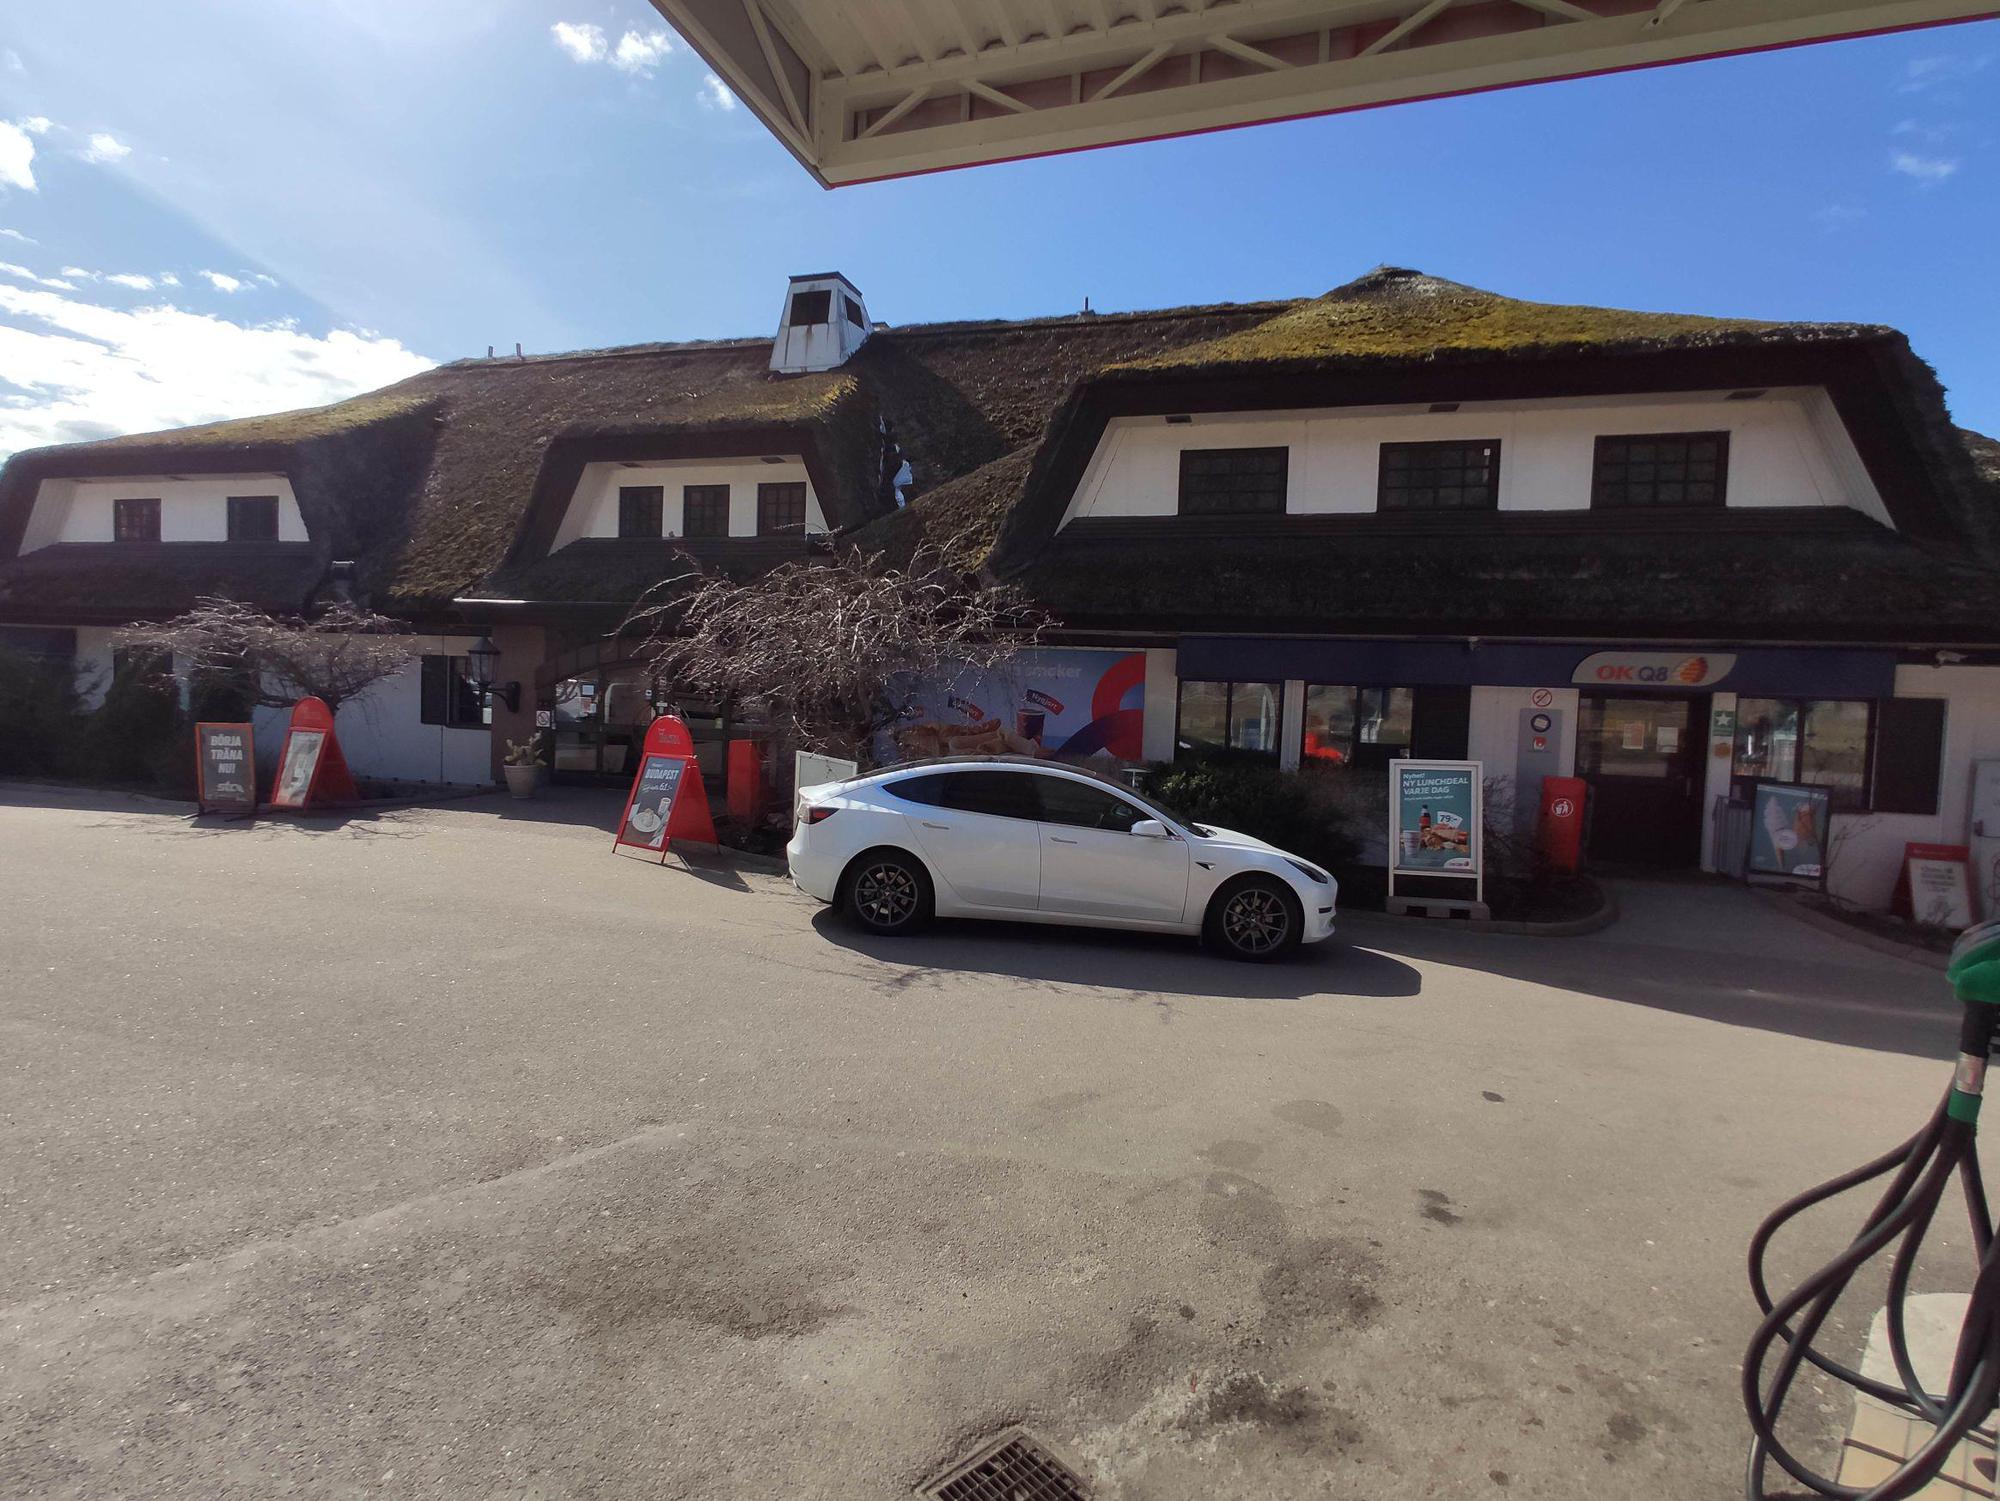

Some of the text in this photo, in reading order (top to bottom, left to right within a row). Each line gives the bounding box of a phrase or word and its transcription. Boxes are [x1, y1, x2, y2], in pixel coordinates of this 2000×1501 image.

[210, 734, 242, 746] BÖRJA
[210, 747, 243, 760] TRÄNA
[645, 768, 680, 780] BUDAPEST
[1416, 777, 1469, 787] LUNCHDEAL
[1403, 786, 1450, 795] VARJE DAG
